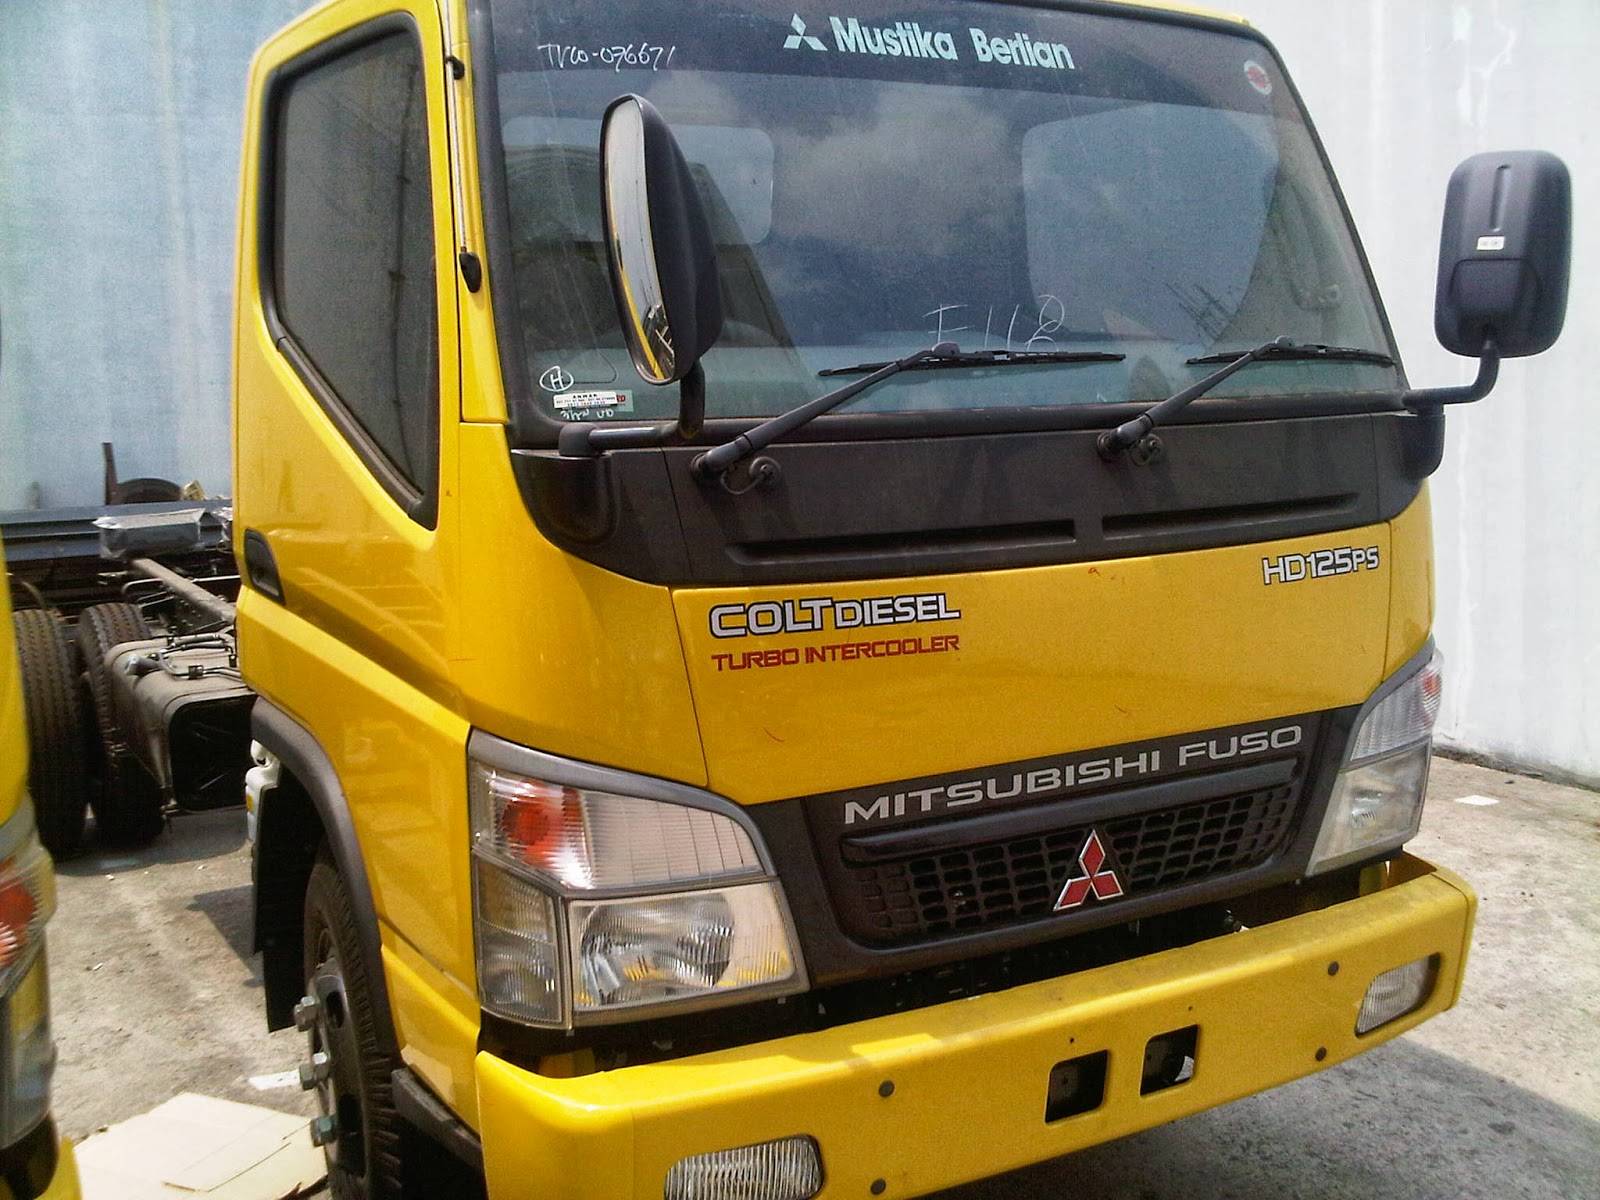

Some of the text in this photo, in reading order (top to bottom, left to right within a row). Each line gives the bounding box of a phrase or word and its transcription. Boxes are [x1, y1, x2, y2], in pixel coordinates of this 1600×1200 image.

[829, 16, 1075, 69] Mustika Berlian
[711, 635, 959, 671] TURBO INTERCOOLER
[844, 725, 1303, 824] MITSUBISHI FUSO
